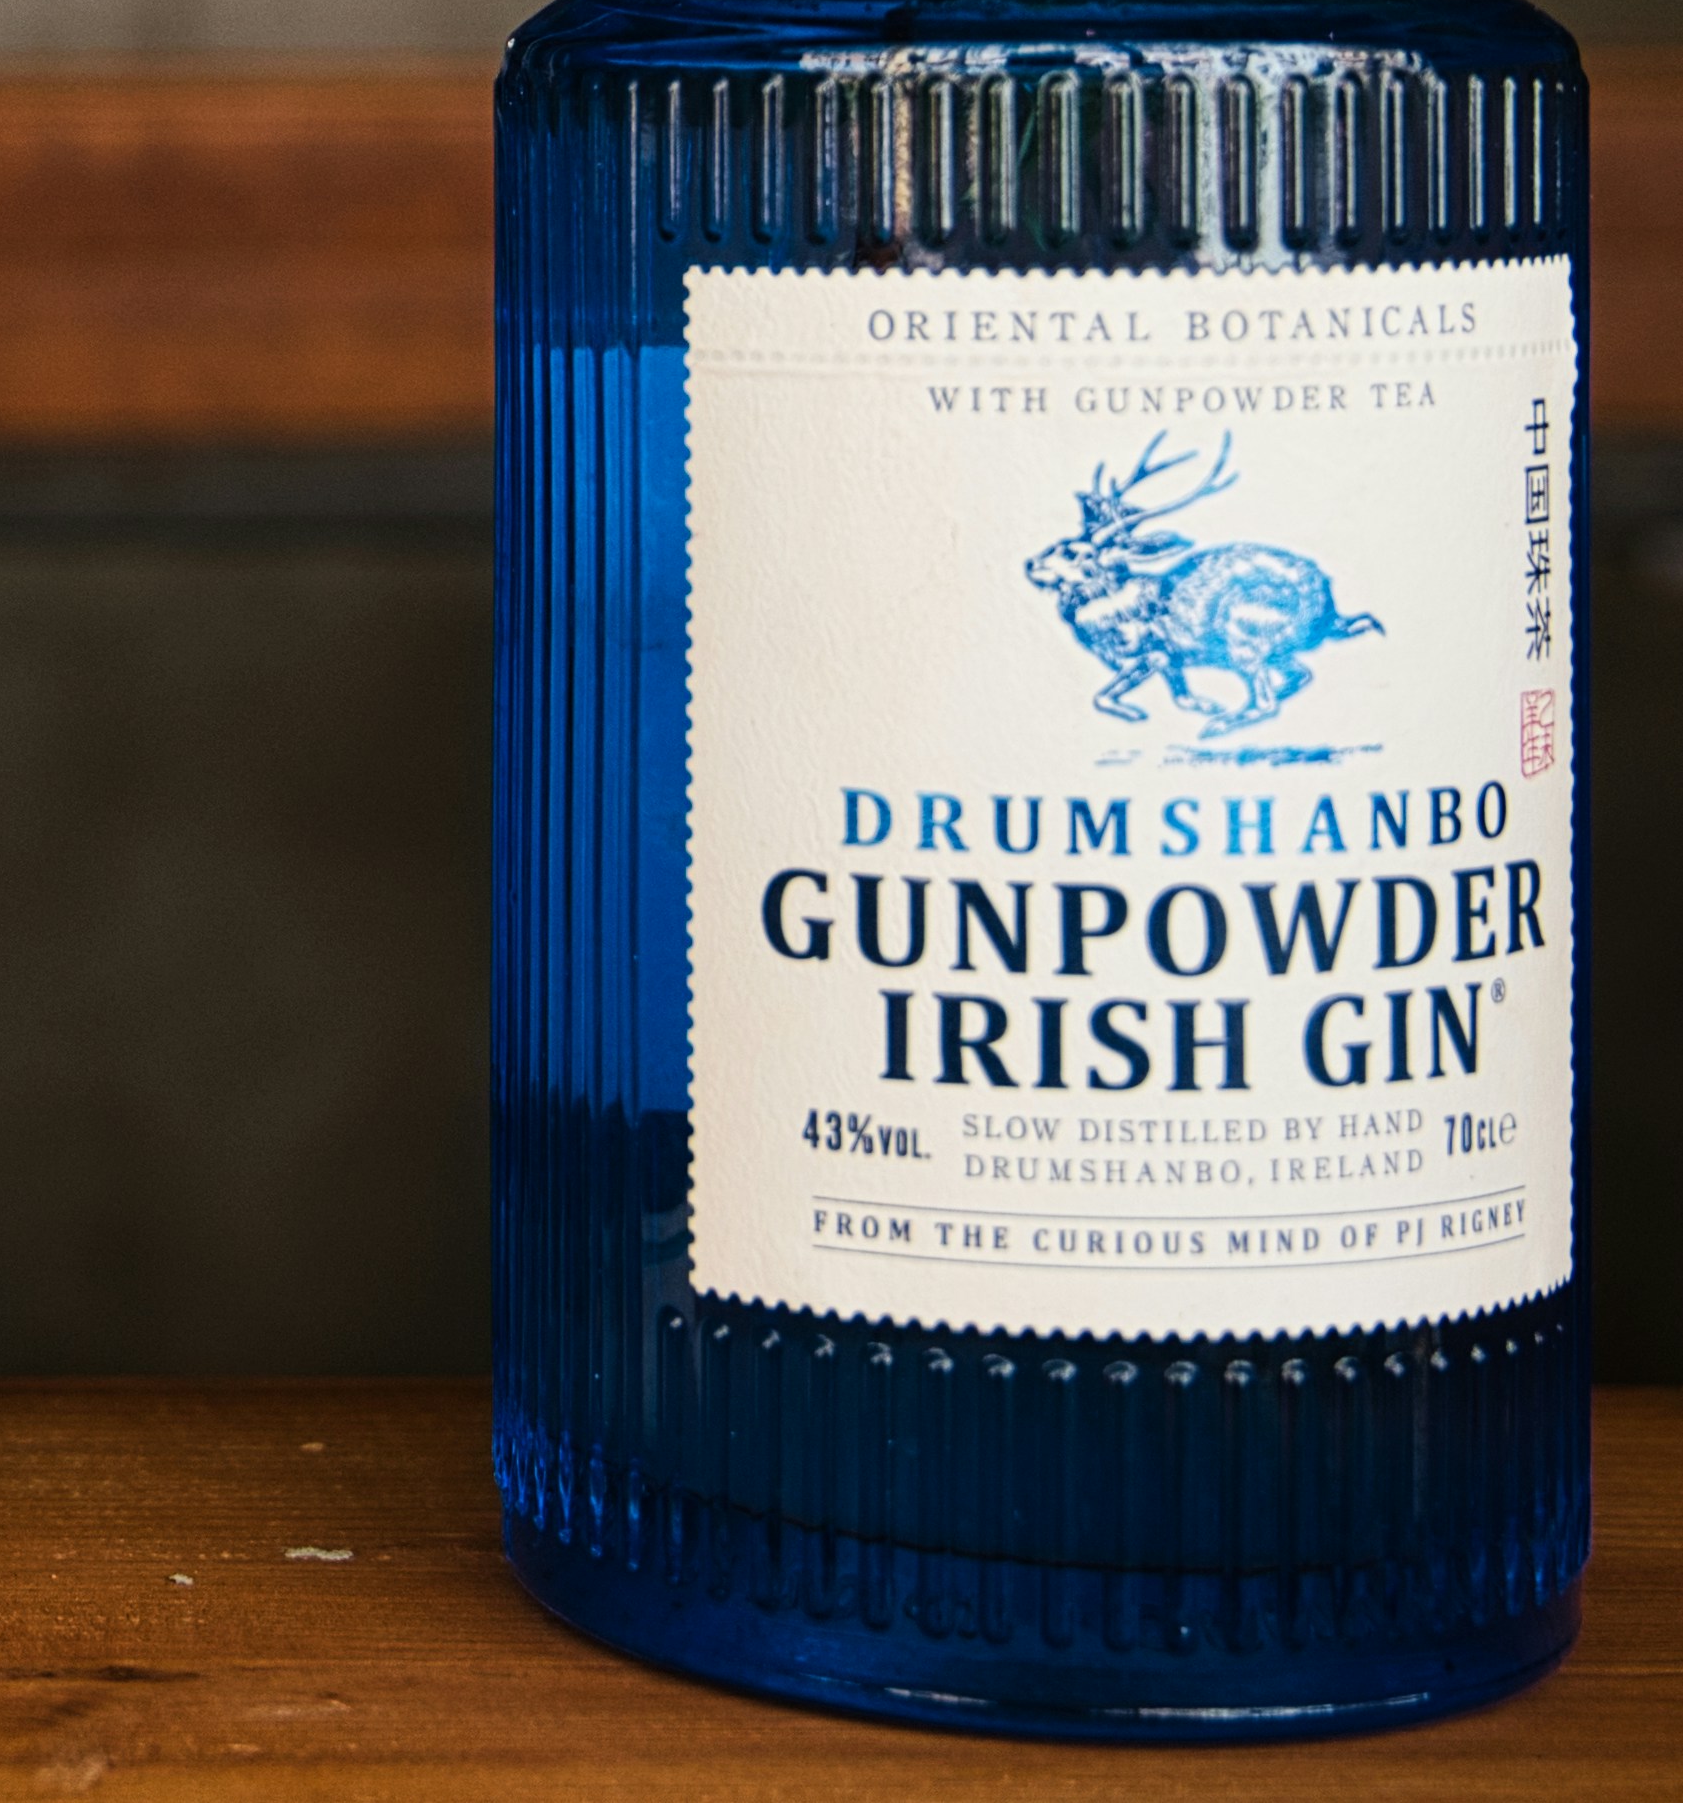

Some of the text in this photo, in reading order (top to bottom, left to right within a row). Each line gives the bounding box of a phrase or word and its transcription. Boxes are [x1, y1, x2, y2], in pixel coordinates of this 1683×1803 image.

[866, 301, 1477, 344] ORIENTAL BOTANICALS
[927, 381, 1437, 415] WITH GUNPOWDER TEA
[1522, 396, 1552, 663] 中国珠茶
[838, 779, 1509, 858] DRUMSHANBO
[759, 858, 1547, 978] GUNPOWDER
[877, 987, 1253, 1094] IRISH
[962, 1106, 1425, 1145] SLOW DISTILLED BY HAND
[964, 1148, 1425, 1187] DRUMSHANBO, IRELAND
[813, 1199, 1526, 1255] FROM THE CURIOUS MIND OF PJ RIGNEY
